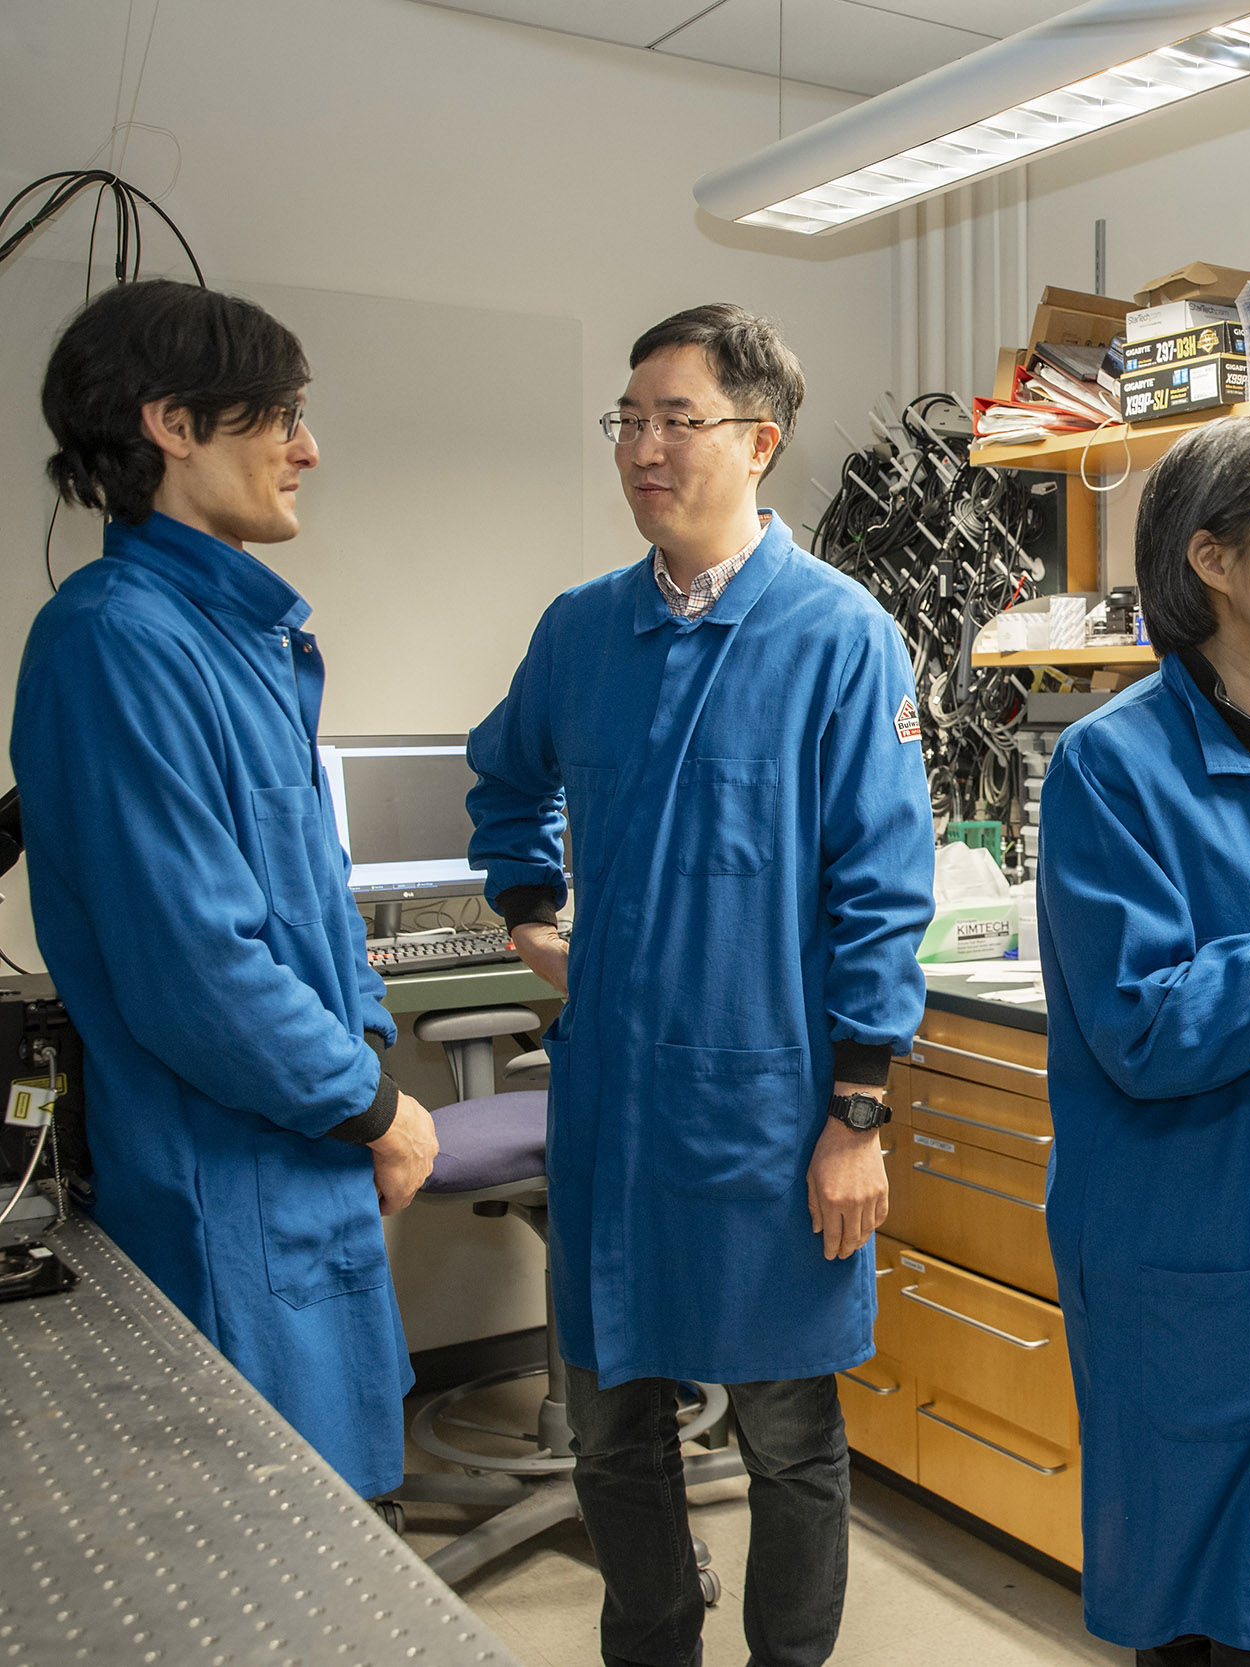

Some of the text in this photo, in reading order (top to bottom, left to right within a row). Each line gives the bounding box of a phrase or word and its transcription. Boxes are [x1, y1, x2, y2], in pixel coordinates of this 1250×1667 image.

[1125, 345, 1152, 357] GIGABYTE
[1156, 335, 1197, 363] Z97-D3H
[1123, 378, 1156, 392] GIGABYTE
[1125, 388, 1169, 417] X99P-SLI
[957, 921, 1009, 935] KIMTECH
